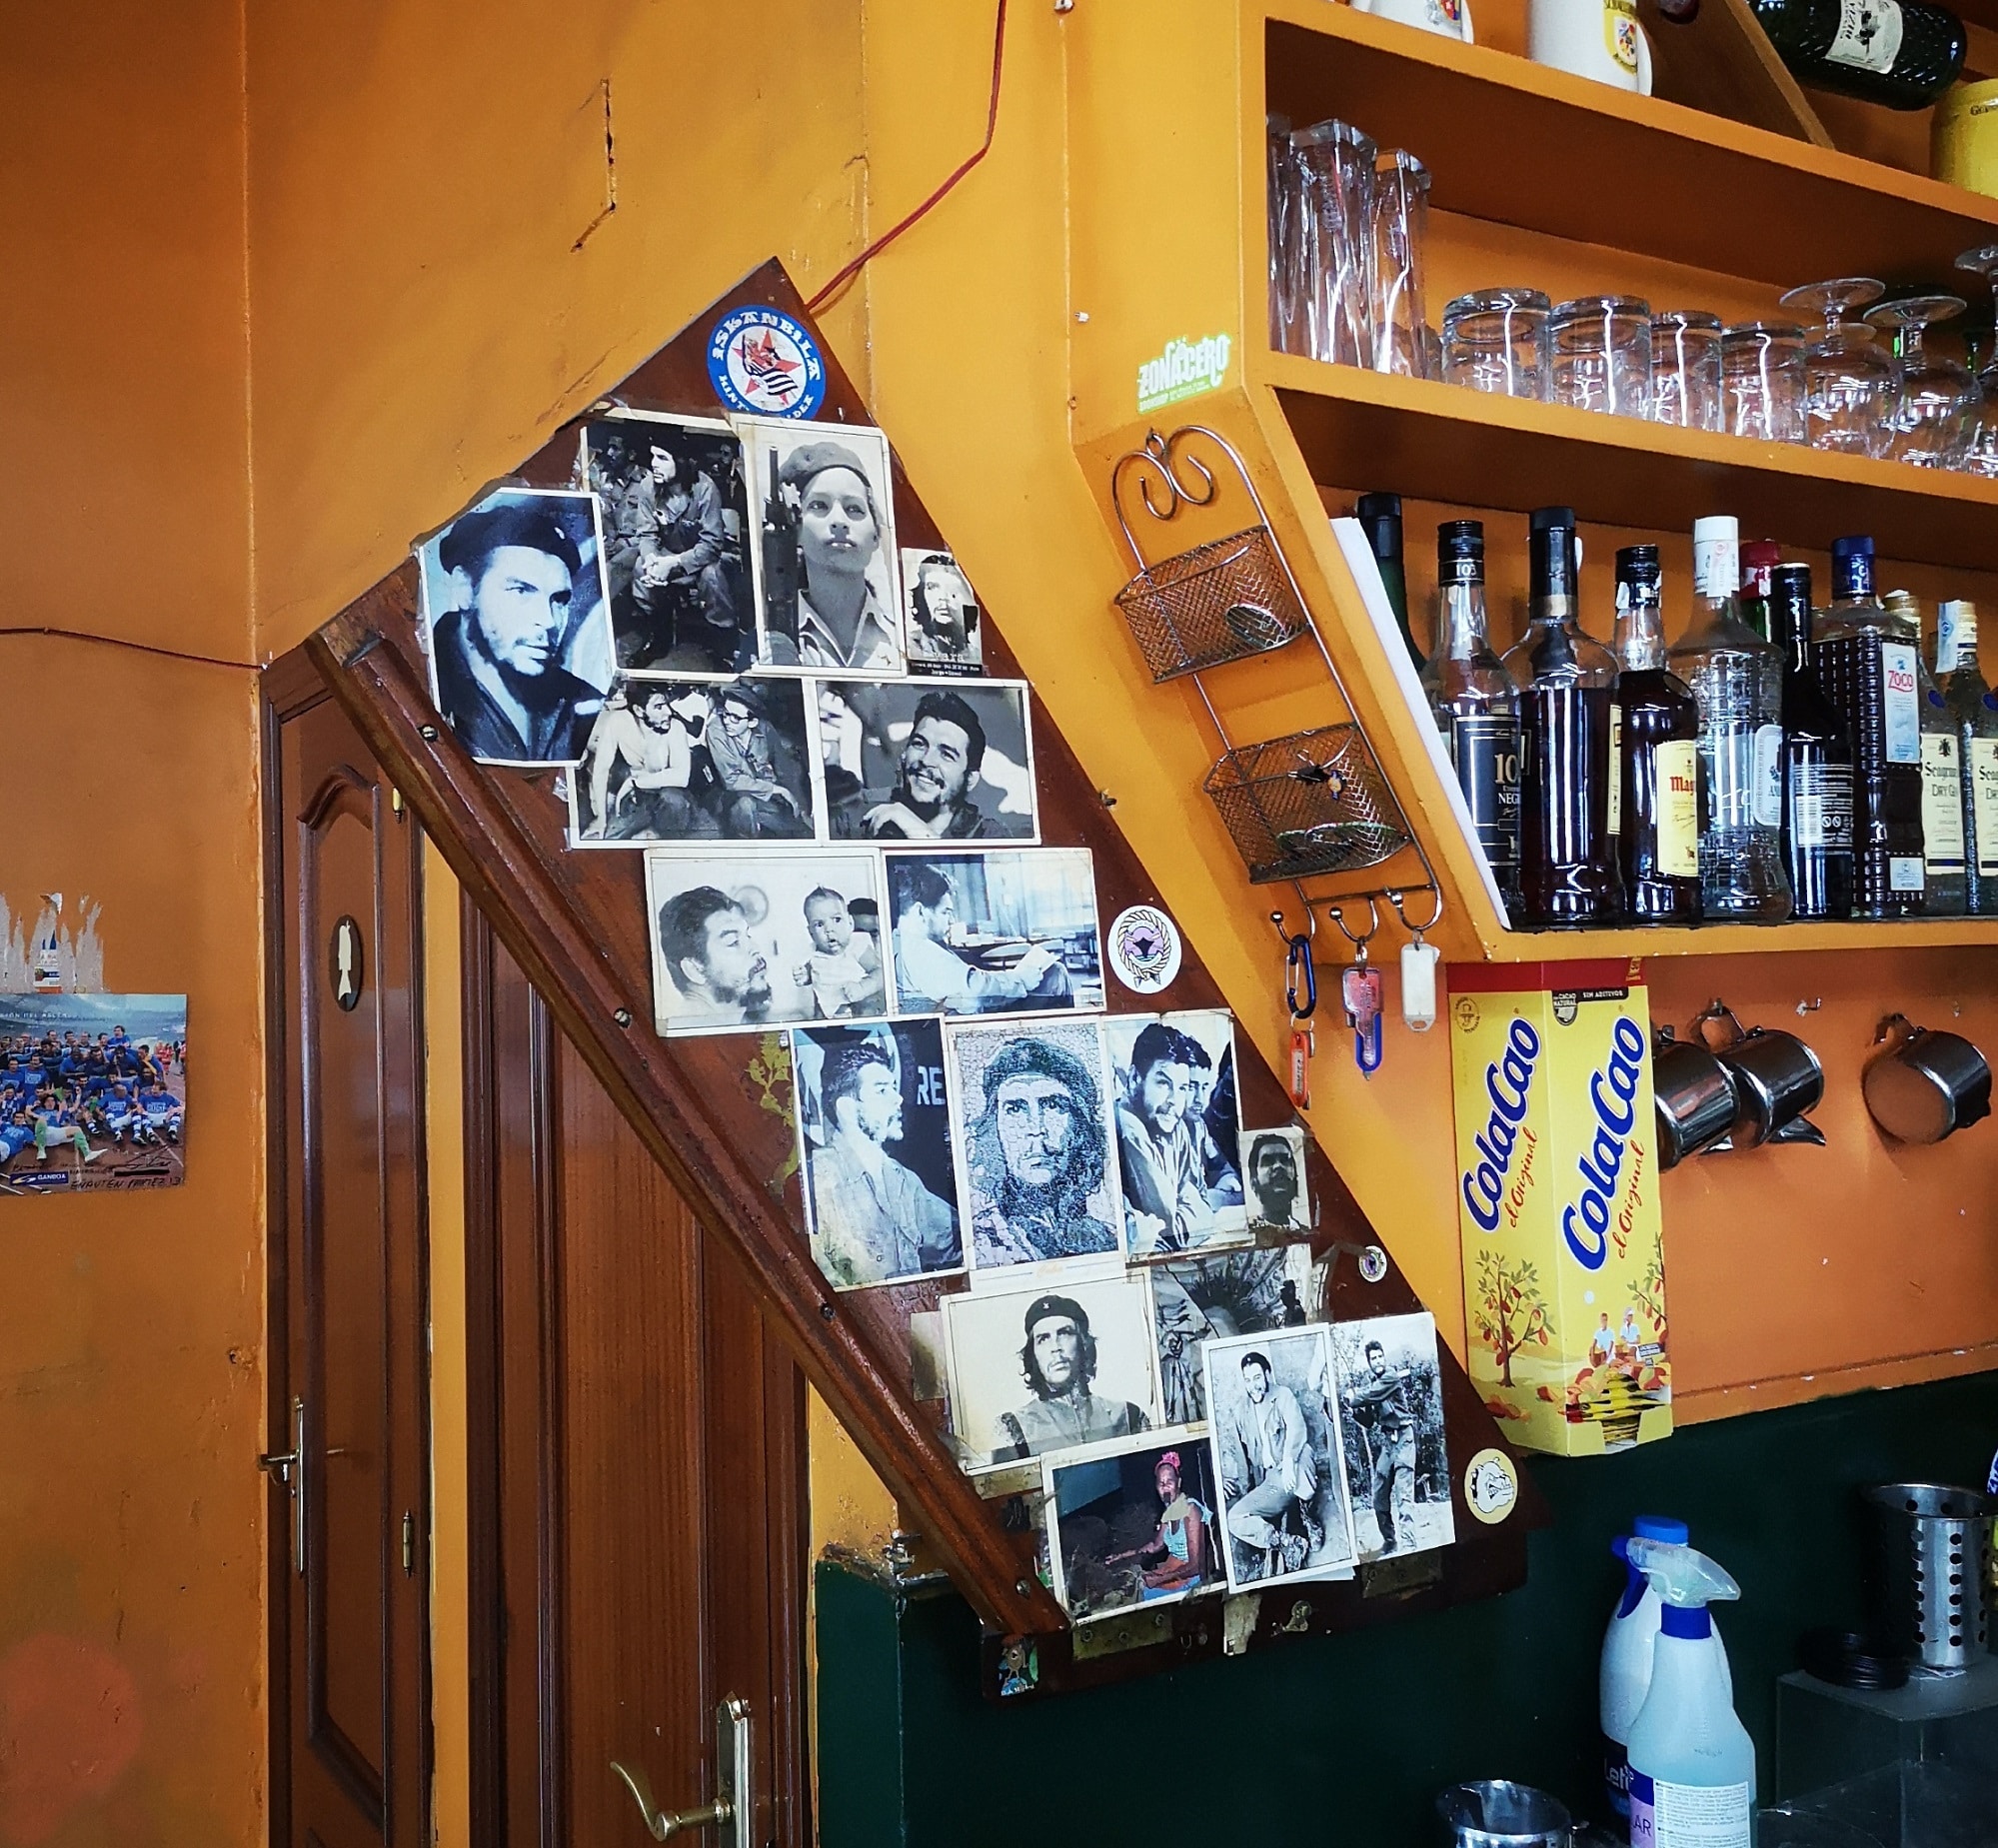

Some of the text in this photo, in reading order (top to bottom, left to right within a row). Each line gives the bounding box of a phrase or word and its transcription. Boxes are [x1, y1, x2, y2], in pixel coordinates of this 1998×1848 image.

[1888, 671, 1914, 689] ZOCO
[1493, 753, 1520, 785] 10
[1498, 793, 1521, 805] NEG
[1669, 776, 1695, 796] Mag
[1463, 1017, 1540, 1231] ColaCao
[1562, 1017, 1646, 1272] ColaCao
[1504, 1126, 1537, 1228] el Original
[1612, 1139, 1644, 1259] el Original
[1632, 1814, 1652, 1837] AR
